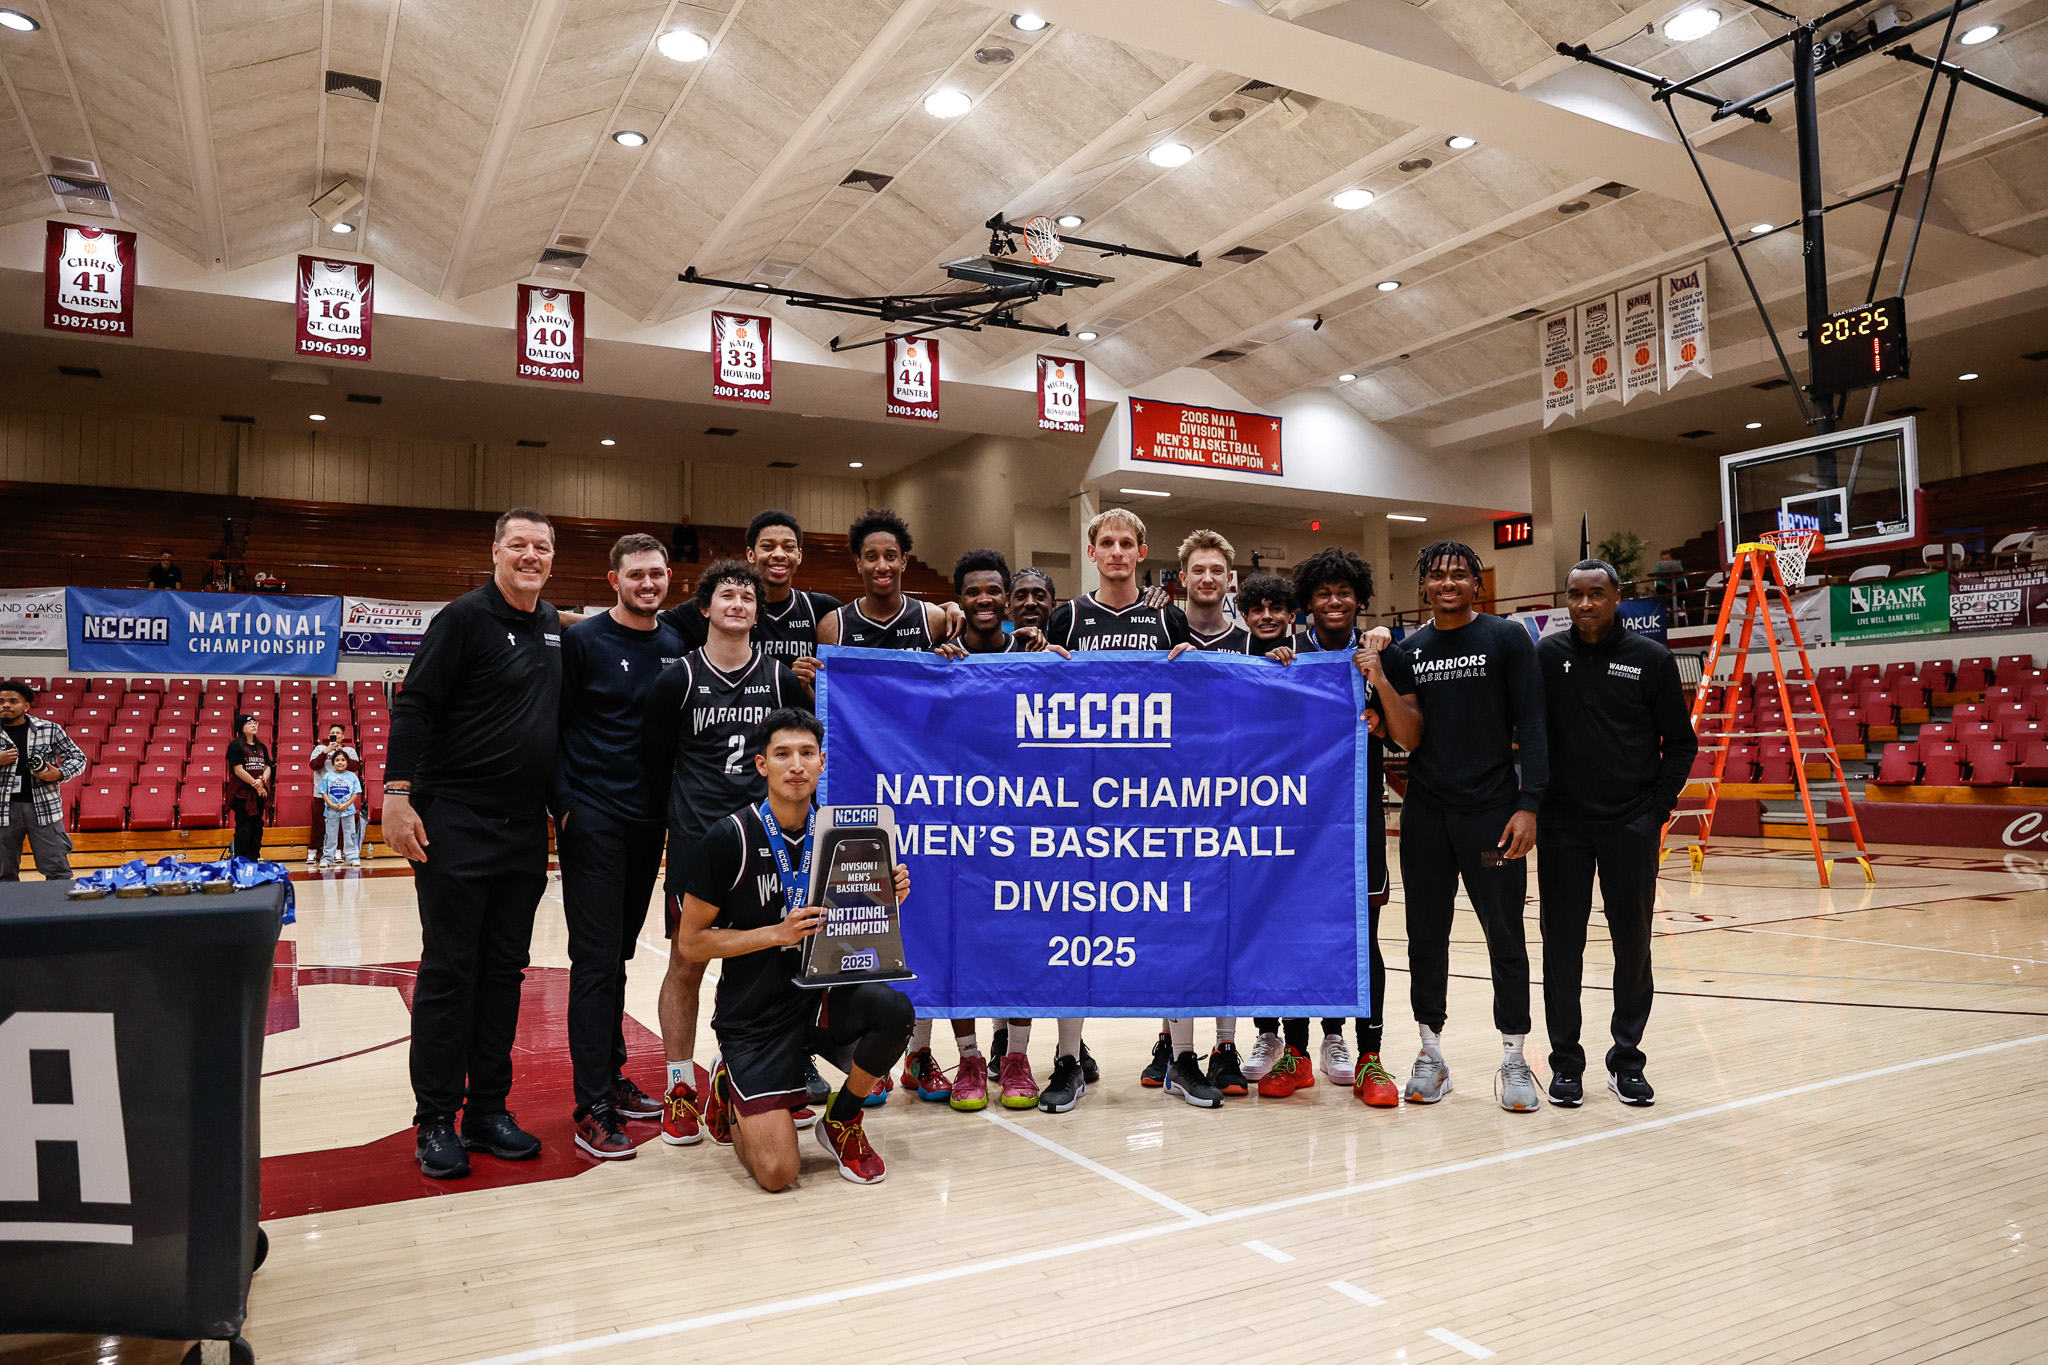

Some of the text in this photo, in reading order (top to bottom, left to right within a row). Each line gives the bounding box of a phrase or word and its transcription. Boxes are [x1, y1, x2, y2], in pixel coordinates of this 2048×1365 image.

[67, 258, 116, 273] CHRIS
[72, 272, 109, 294] 41
[1670, 270, 1700, 297] NAIA
[62, 294, 119, 309] LARSEN
[314, 288, 356, 302] RACHEL
[1626, 291, 1652, 314] NAIA
[1669, 294, 1693, 306] COLLEGE
[1680, 296, 1705, 308] OZARKS
[320, 300, 350, 320] 16
[1626, 310, 1650, 322] DIVISION
[1672, 308, 1696, 318] DIVISION
[1832, 302, 1873, 318] DAKTRONICS
[53, 314, 126, 332] 1987-1991
[308, 320, 360, 335] ST. CLAIR
[530, 315, 570, 328] AARON
[1628, 322, 1654, 334] NATIONAL
[1672, 322, 1704, 334] BASKETBALL
[1674, 318, 1699, 328] NATIONAL
[1820, 308, 1889, 345] 20:25
[534, 328, 566, 346] 40
[1626, 326, 1657, 340] BASKETBALL
[1671, 326, 1706, 340] TOURNAMENT
[300, 340, 367, 356] 1996-1999
[730, 340, 756, 350] KATIE
[1584, 338, 1612, 350] BASKETBALL
[1584, 342, 1615, 355] TOURNAMENT
[528, 348, 571, 360] DALTON
[728, 350, 756, 368] 33
[1874, 338, 1881, 372] 1
[520, 364, 580, 379] 1996-2000
[723, 369, 762, 380] HOWARD
[1630, 363, 1657, 375] CHAMPION
[900, 369, 926, 386] 44
[1628, 372, 1650, 383] COLLEGE
[714, 384, 770, 400] 2001-2005
[896, 388, 929, 398] PAINTER
[1046, 381, 1076, 394] MICHAEL
[1586, 381, 1608, 390] COLLEGE
[1597, 384, 1616, 394] OZARKS
[1628, 382, 1638, 390] THE
[1052, 392, 1072, 406] 10
[1546, 394, 1568, 404] COLLEGE
[1546, 402, 1556, 410] THE
[888, 404, 938, 419] 2003-2006
[1046, 408, 1077, 418] BONAPARTE
[1182, 410, 1236, 428] 2006 NAIA
[1038, 418, 1084, 432] 2004-2007
[1180, 422, 1238, 440] DIVISION II
[1156, 432, 1260, 456] MEN'S BASKETBALL
[1153, 444, 1264, 470] NATIONAL CHAMPION
[1984, 570, 2046, 582] PROVIDER FOR THE
[1959, 583, 1988, 592] COLLEGE
[2014, 578, 2041, 586] OZARKS
[1872, 586, 1926, 606] BANK
[26, 604, 62, 613] OAKS
[372, 608, 422, 616] GETTING
[1886, 600, 1926, 610] MISSOURI
[1952, 598, 2020, 615] SPORTS
[189, 611, 326, 636] NATIONAL
[356, 615, 422, 627] Floor'D
[1130, 616, 1157, 625] NUAZ
[1622, 615, 1660, 630] AKUK
[1858, 614, 1904, 626] LIVE WELL. BANK
[1976, 612, 2020, 620] BATTLEFIELD
[84, 616, 168, 640] NCCAA
[896, 627, 921, 637] NUAZ
[188, 638, 326, 654] CHAMPIONSHIP
[751, 640, 812, 658] ARRIORS
[1078, 634, 1158, 651] WARRIORS
[1412, 654, 1486, 674] WARRIORS
[1609, 662, 1642, 674] WARRIORS
[1414, 668, 1486, 685] BASKETBALL
[1607, 670, 1640, 680] BASKETBALL
[1016, 692, 1172, 739] NCCAA
[724, 734, 746, 775] 2
[876, 774, 1308, 808] NATIONAL CHAMPION
[835, 808, 878, 824] NCCAA
[764, 814, 778, 836] NCCAA
[808, 814, 816, 836] NCCAA
[895, 824, 1296, 858] MEN'S BASKETBALL
[777, 849, 790, 873] NCCAA
[802, 850, 812, 874] NCCAA
[840, 862, 878, 872] DIVISION I
[848, 872, 870, 882] MEN'S
[836, 882, 882, 894] BASKETBALL
[994, 880, 1192, 912] DIVISION I
[828, 906, 888, 922] NATIONAL
[826, 920, 890, 937] CHAMPION
[1048, 936, 1136, 968] 2025
[842, 954, 874, 970] 2025
